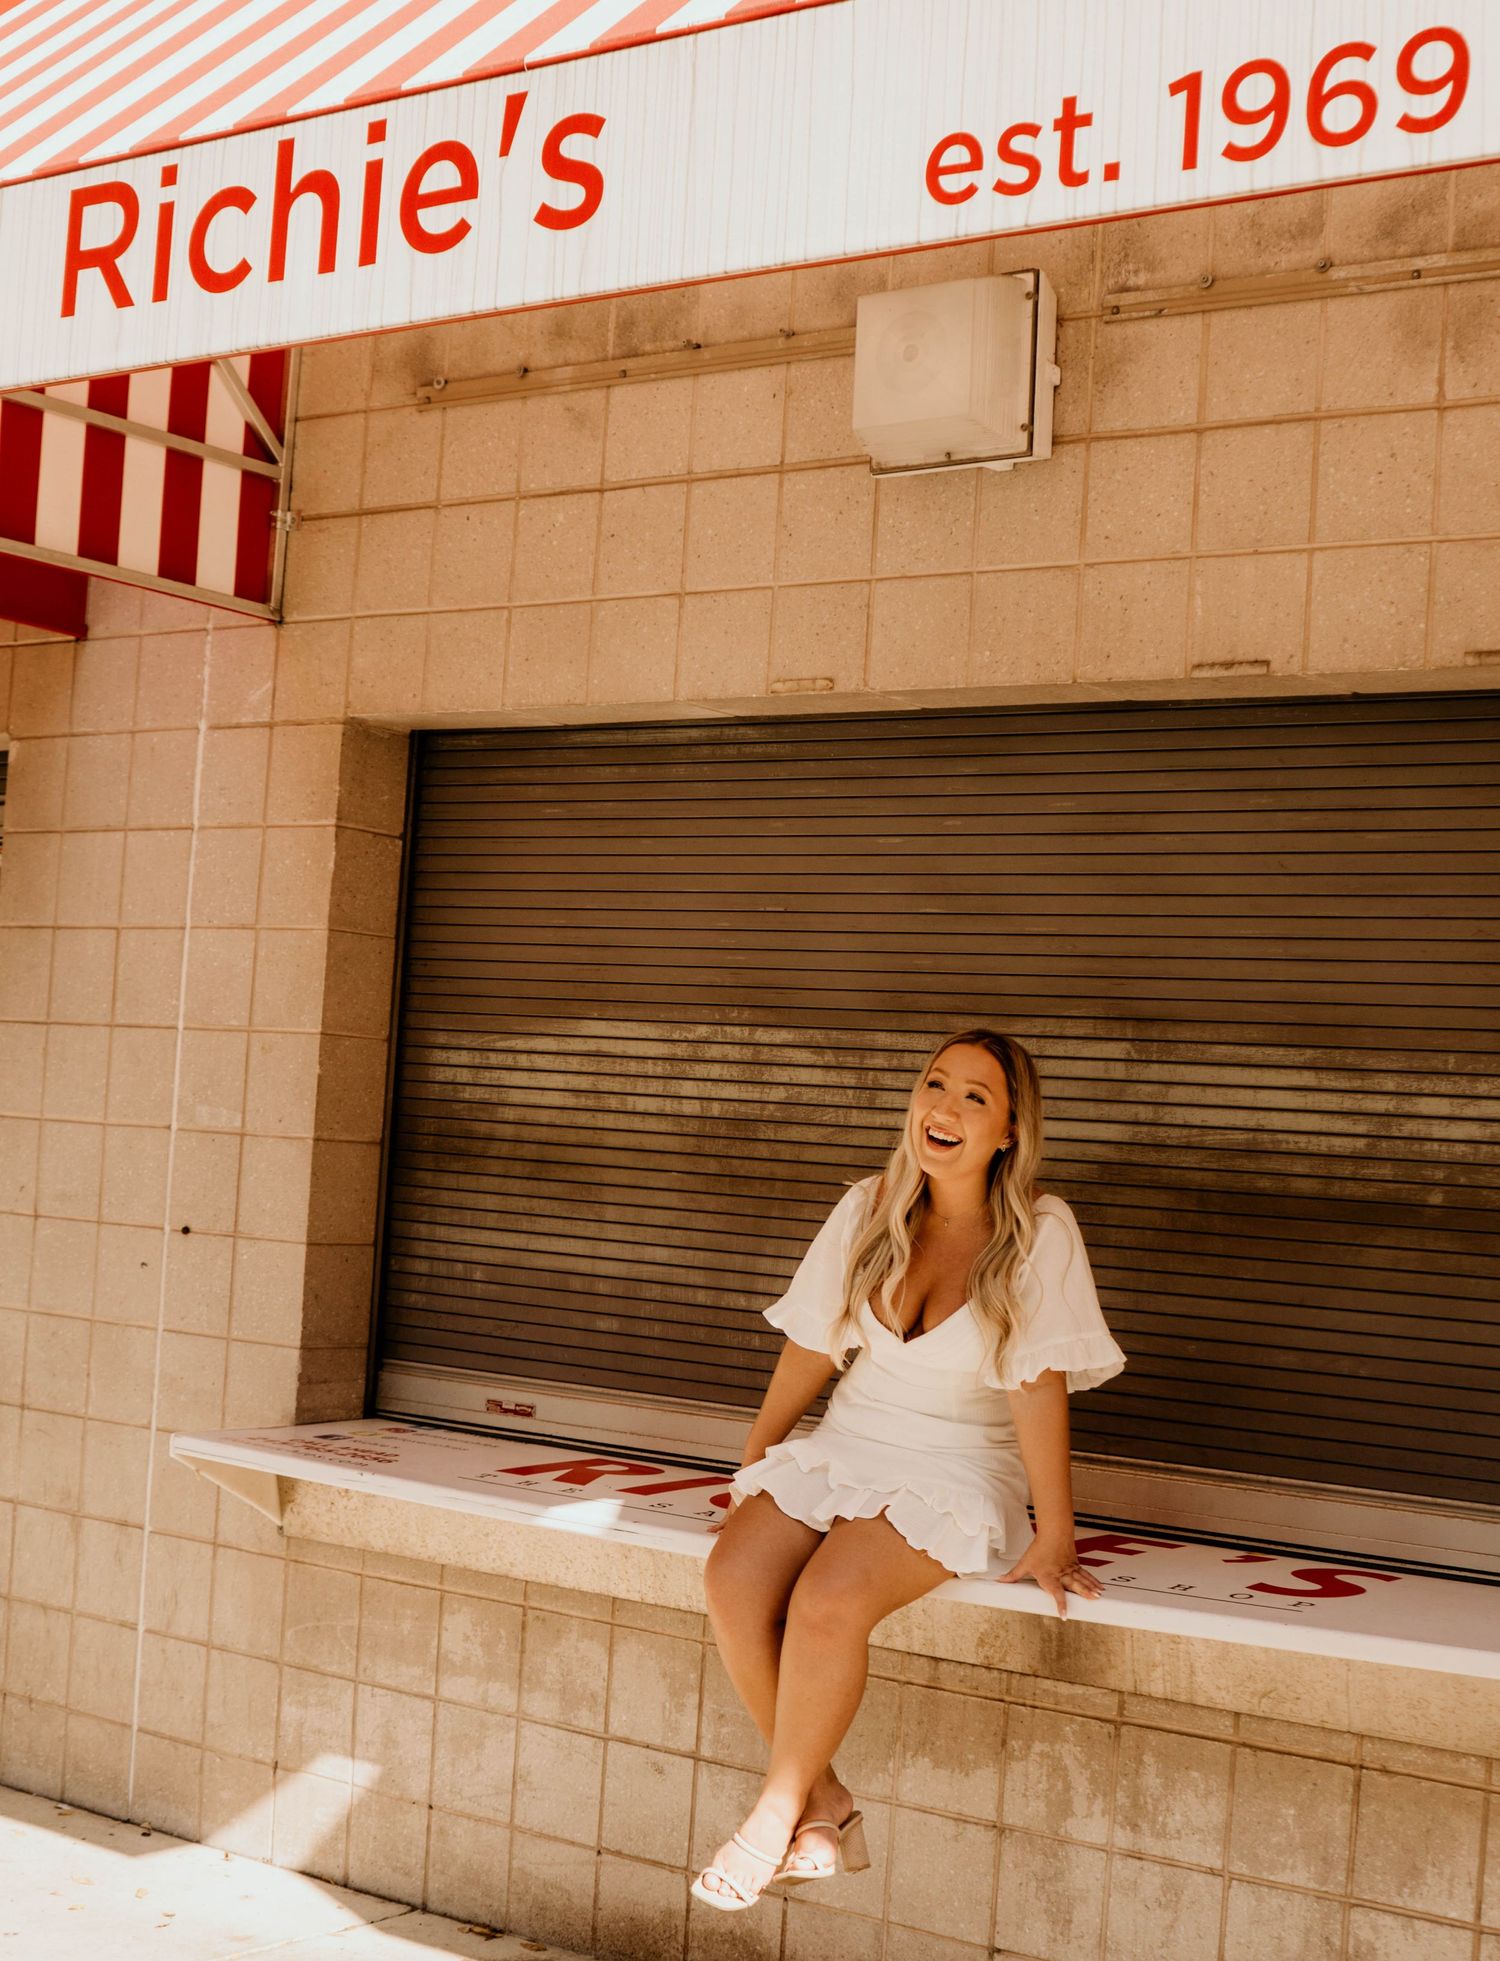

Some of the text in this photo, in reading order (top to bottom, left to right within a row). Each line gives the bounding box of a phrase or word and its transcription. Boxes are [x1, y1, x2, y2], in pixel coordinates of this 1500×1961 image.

[60, 91, 606, 319] Richie's
[925, 26, 1470, 206] est. 1969
[476, 1472, 1315, 1607] THE SHOP
